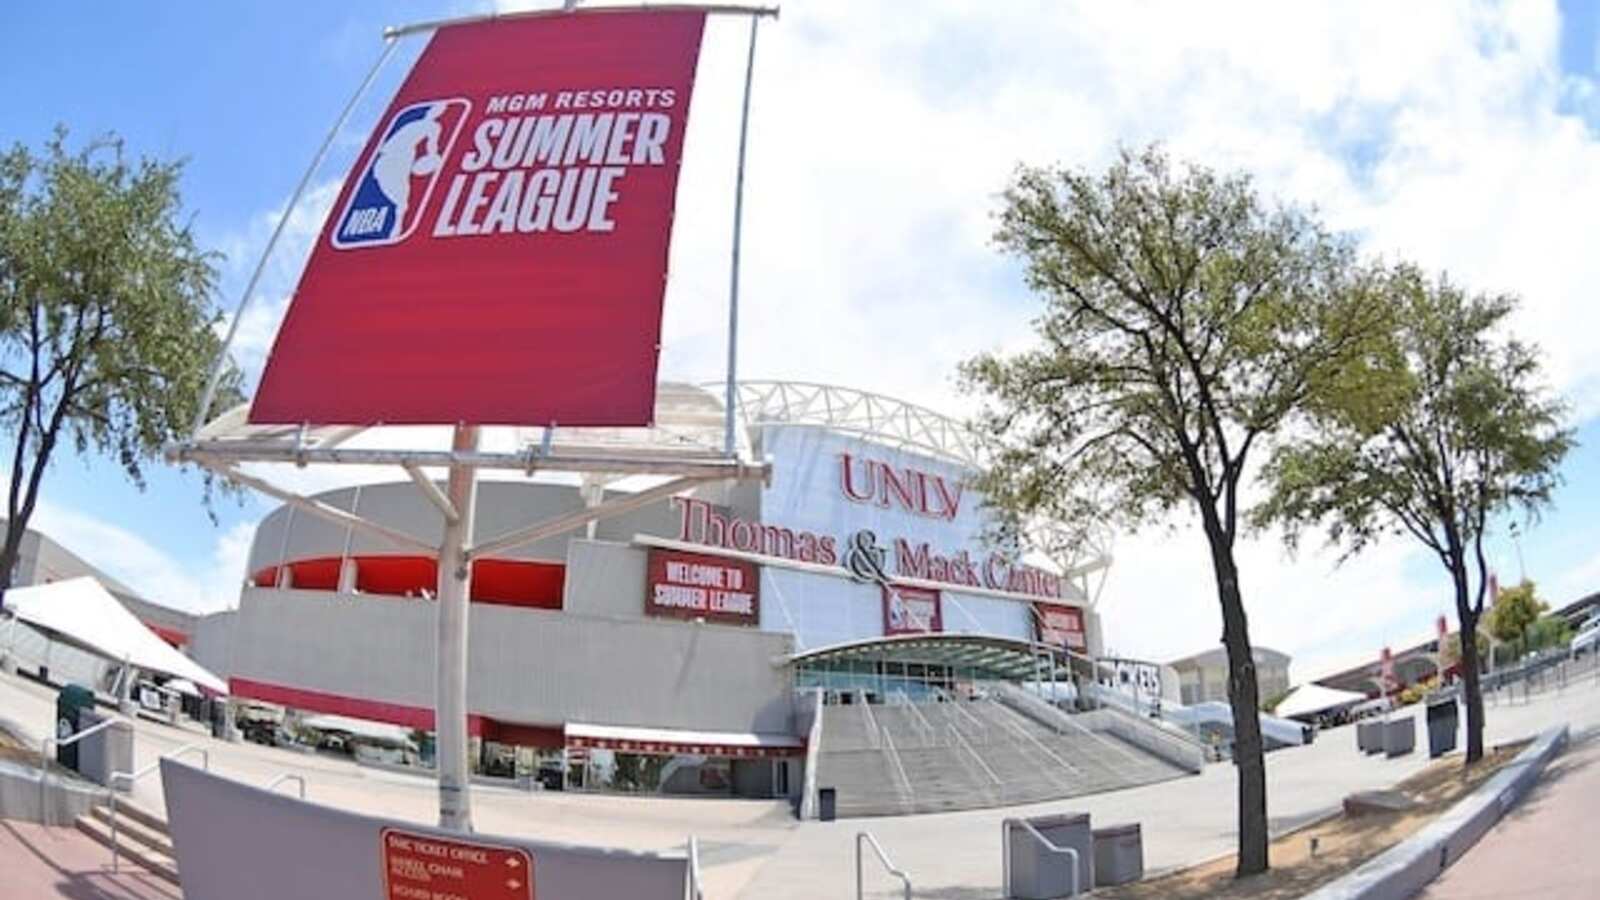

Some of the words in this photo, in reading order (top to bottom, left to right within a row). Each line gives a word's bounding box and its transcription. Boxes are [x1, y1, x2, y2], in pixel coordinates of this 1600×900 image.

[486, 93, 547, 113] MGM
[555, 89, 676, 108] RESORTS
[461, 112, 671, 171] SUMMER
[342, 206, 389, 236] NBA
[433, 167, 626, 238] LEAGUE
[840, 452, 965, 522] UNLV
[673, 496, 837, 566] Thomas
[843, 529, 890, 584] &
[896, 537, 981, 588] Mack
[666, 561, 724, 587] WELCOME
[726, 567, 743, 590] TO
[654, 583, 707, 610] SUMMER
[709, 588, 753, 615] LEAGUE
